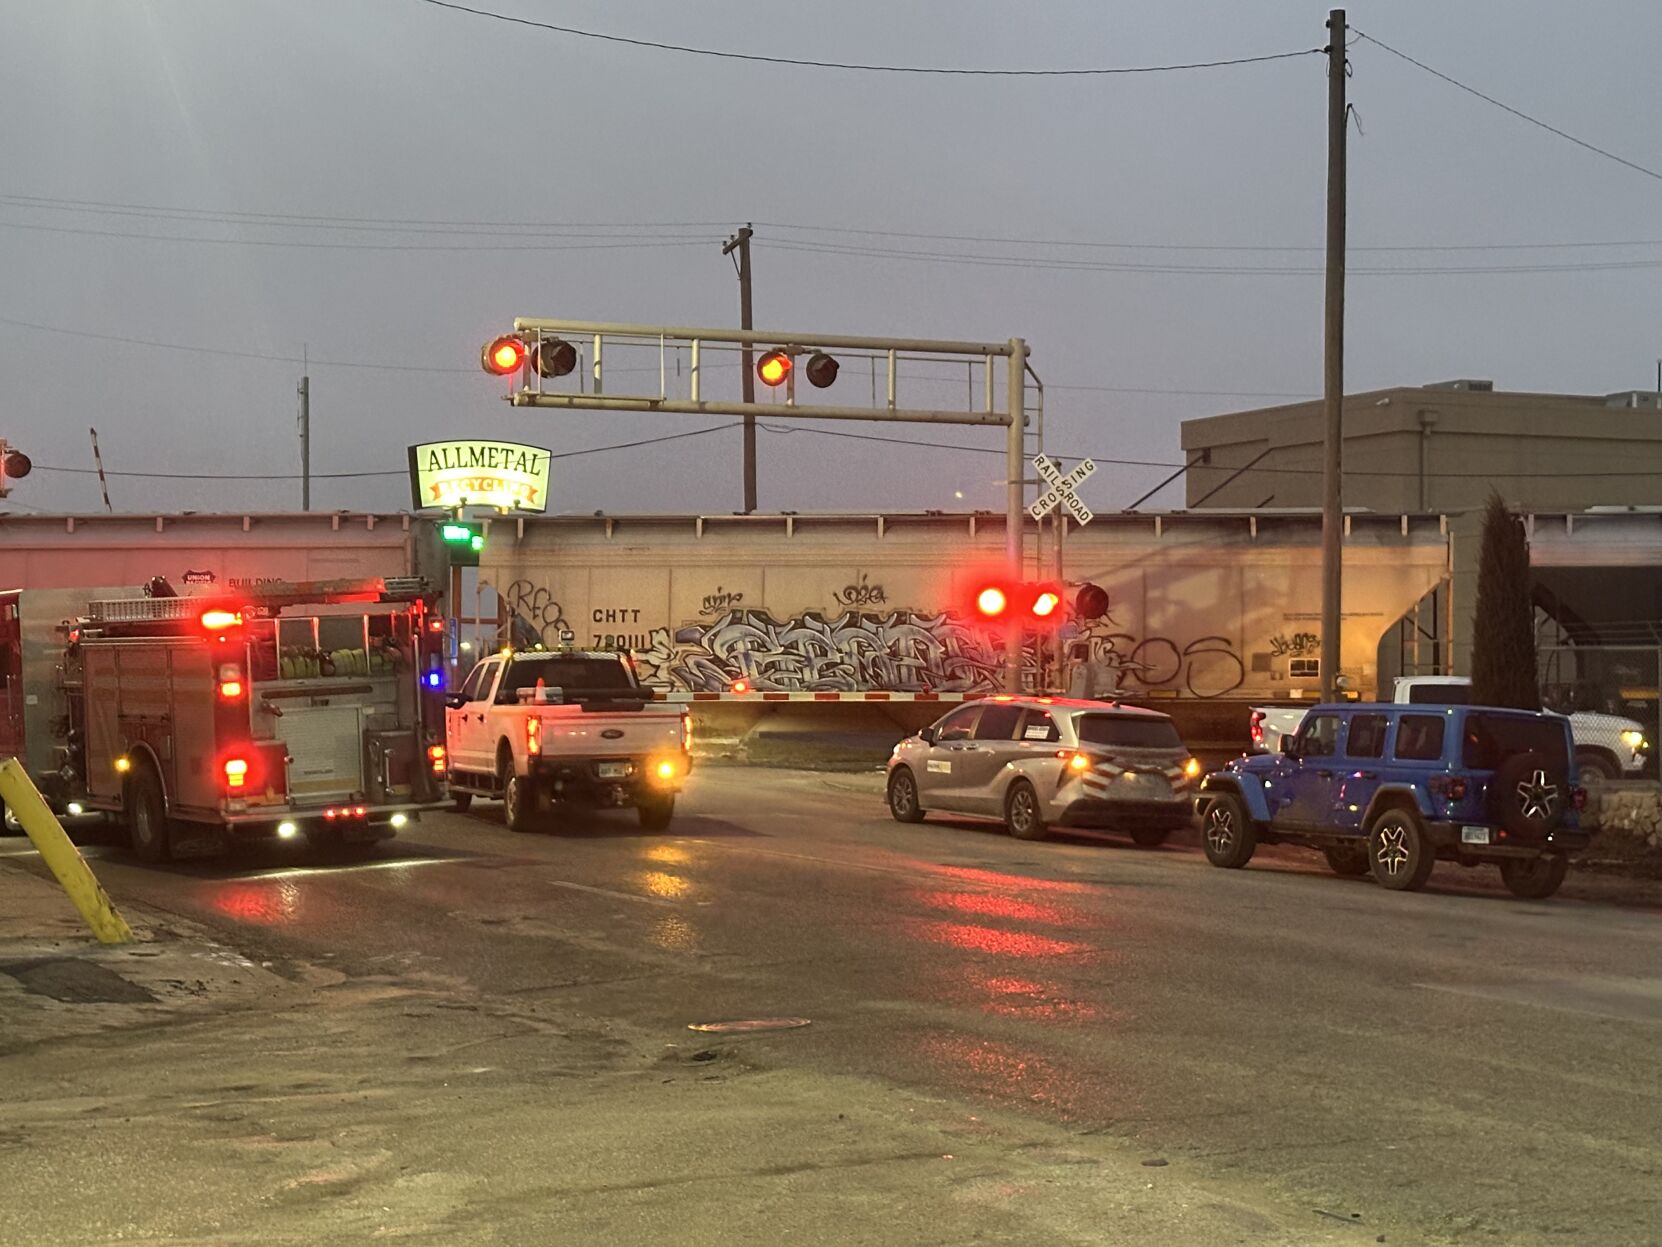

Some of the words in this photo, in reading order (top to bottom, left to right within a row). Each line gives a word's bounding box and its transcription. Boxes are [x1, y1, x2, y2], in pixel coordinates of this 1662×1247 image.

[428, 446, 541, 476] ALLMETAL
[1031, 460, 1094, 516] CROSSING
[1034, 456, 1089, 521] RAILROAD
[592, 609, 641, 623] CHTT
